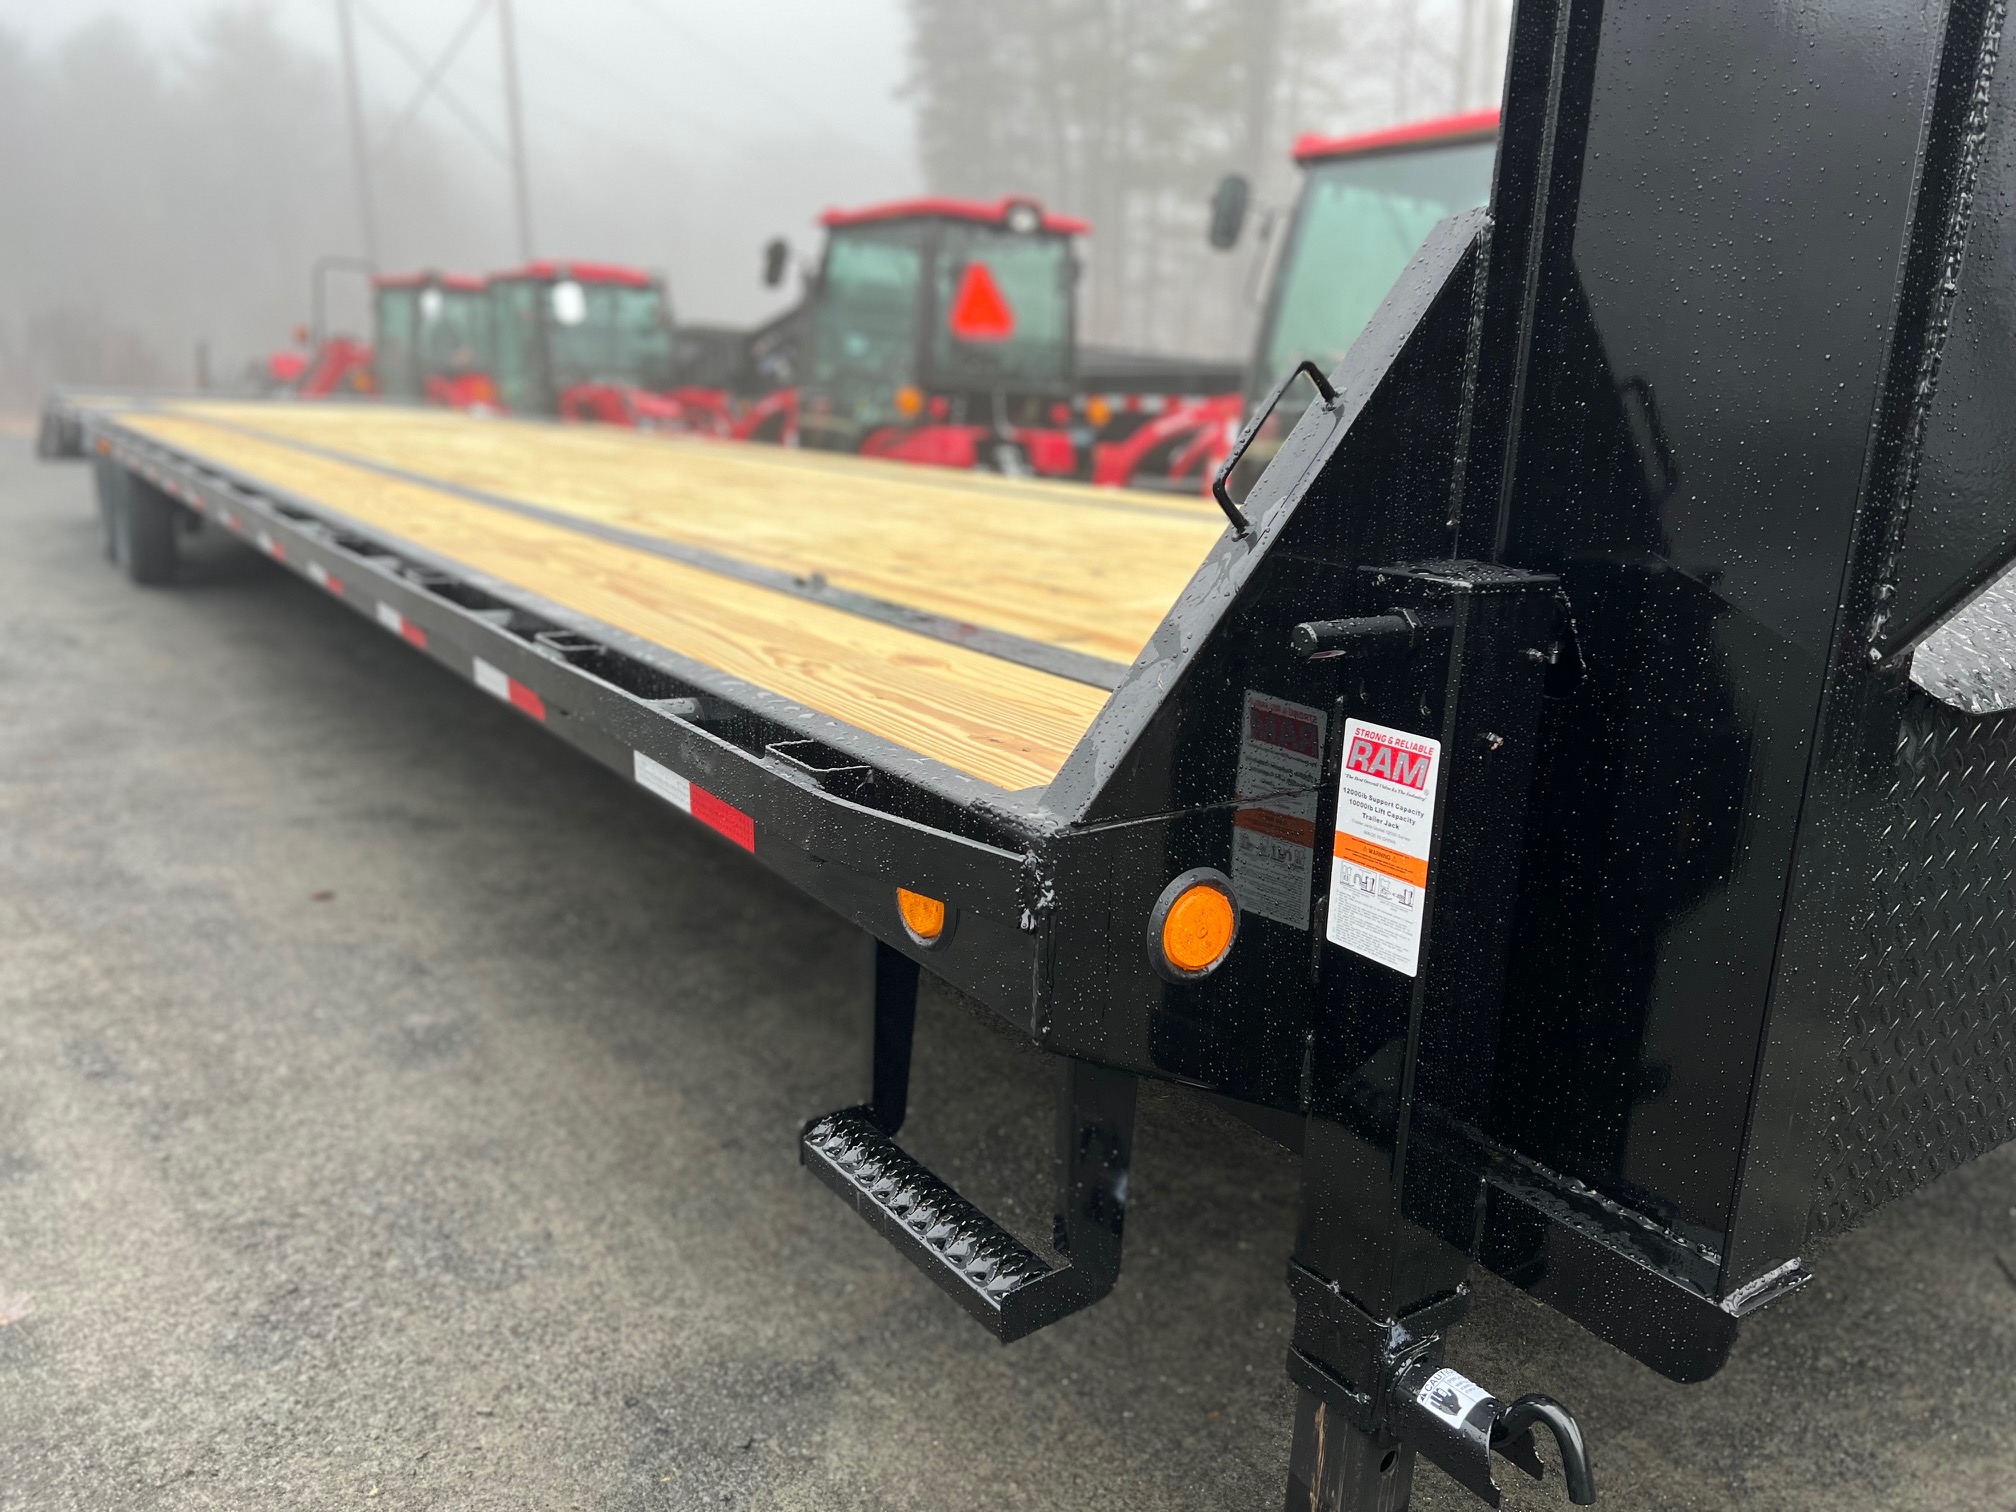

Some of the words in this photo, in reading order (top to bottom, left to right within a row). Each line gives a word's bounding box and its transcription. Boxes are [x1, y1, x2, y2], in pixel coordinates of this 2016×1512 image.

[1355, 727, 1387, 743] STRONG
[1387, 736, 1394, 745] &
[1394, 738, 1435, 756] RELIABLE
[1348, 739, 1429, 788] RAM
[1342, 787, 1368, 800] 12000lb
[1368, 794, 1394, 808] Support
[1395, 803, 1425, 819] Capacity
[1349, 798, 1374, 812] 10000lb
[1374, 806, 1386, 816] Lift
[1386, 810, 1416, 826] Capacity
[1362, 812, 1383, 824] Trailer
[1384, 820, 1400, 830] Jack
[1382, 836, 1396, 844] CHINA
[1368, 848, 1391, 861] WARNING
